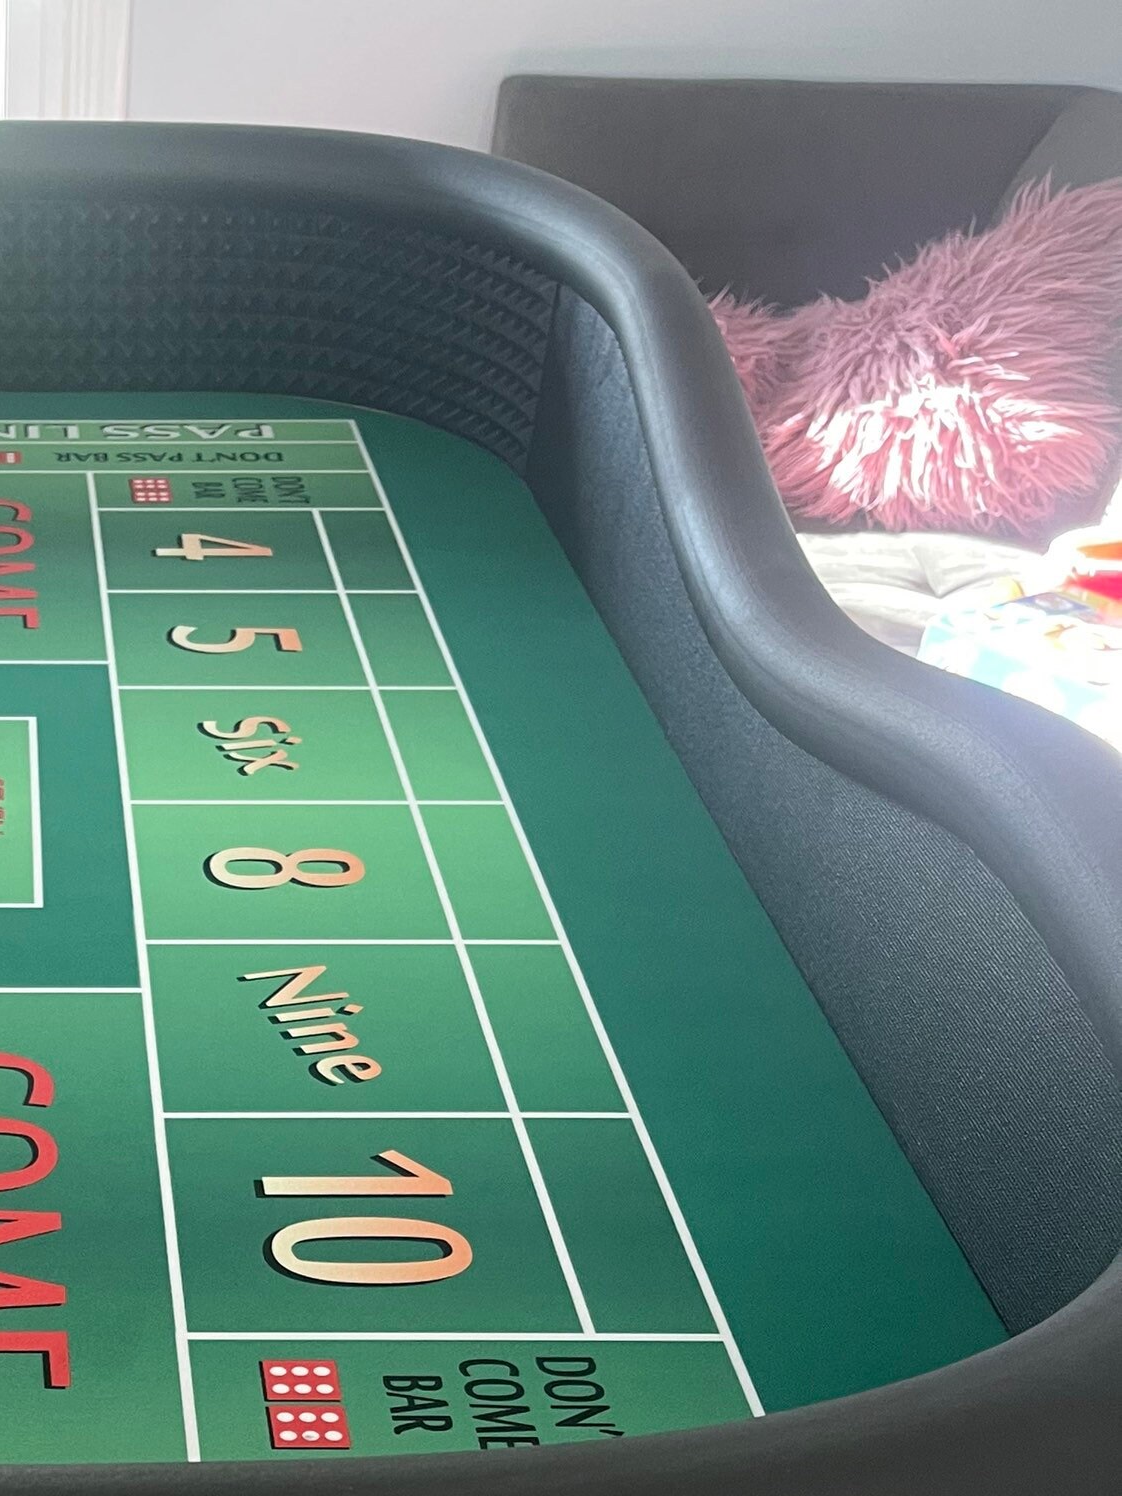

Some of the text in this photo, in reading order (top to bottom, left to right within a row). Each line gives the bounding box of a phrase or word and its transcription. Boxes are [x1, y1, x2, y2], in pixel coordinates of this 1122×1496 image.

[101, 423, 275, 439] PASS
[56, 452, 284, 462] DON'T PASS BAR
[153, 533, 272, 561] 4
[167, 626, 302, 654] 5
[198, 716, 302, 776] Six
[203, 847, 365, 889] 8
[237, 965, 383, 1086] Nine
[253, 1150, 473, 1287] 10
[382, 1375, 453, 1434] BAR
[459, 1359, 540, 1450] COME
